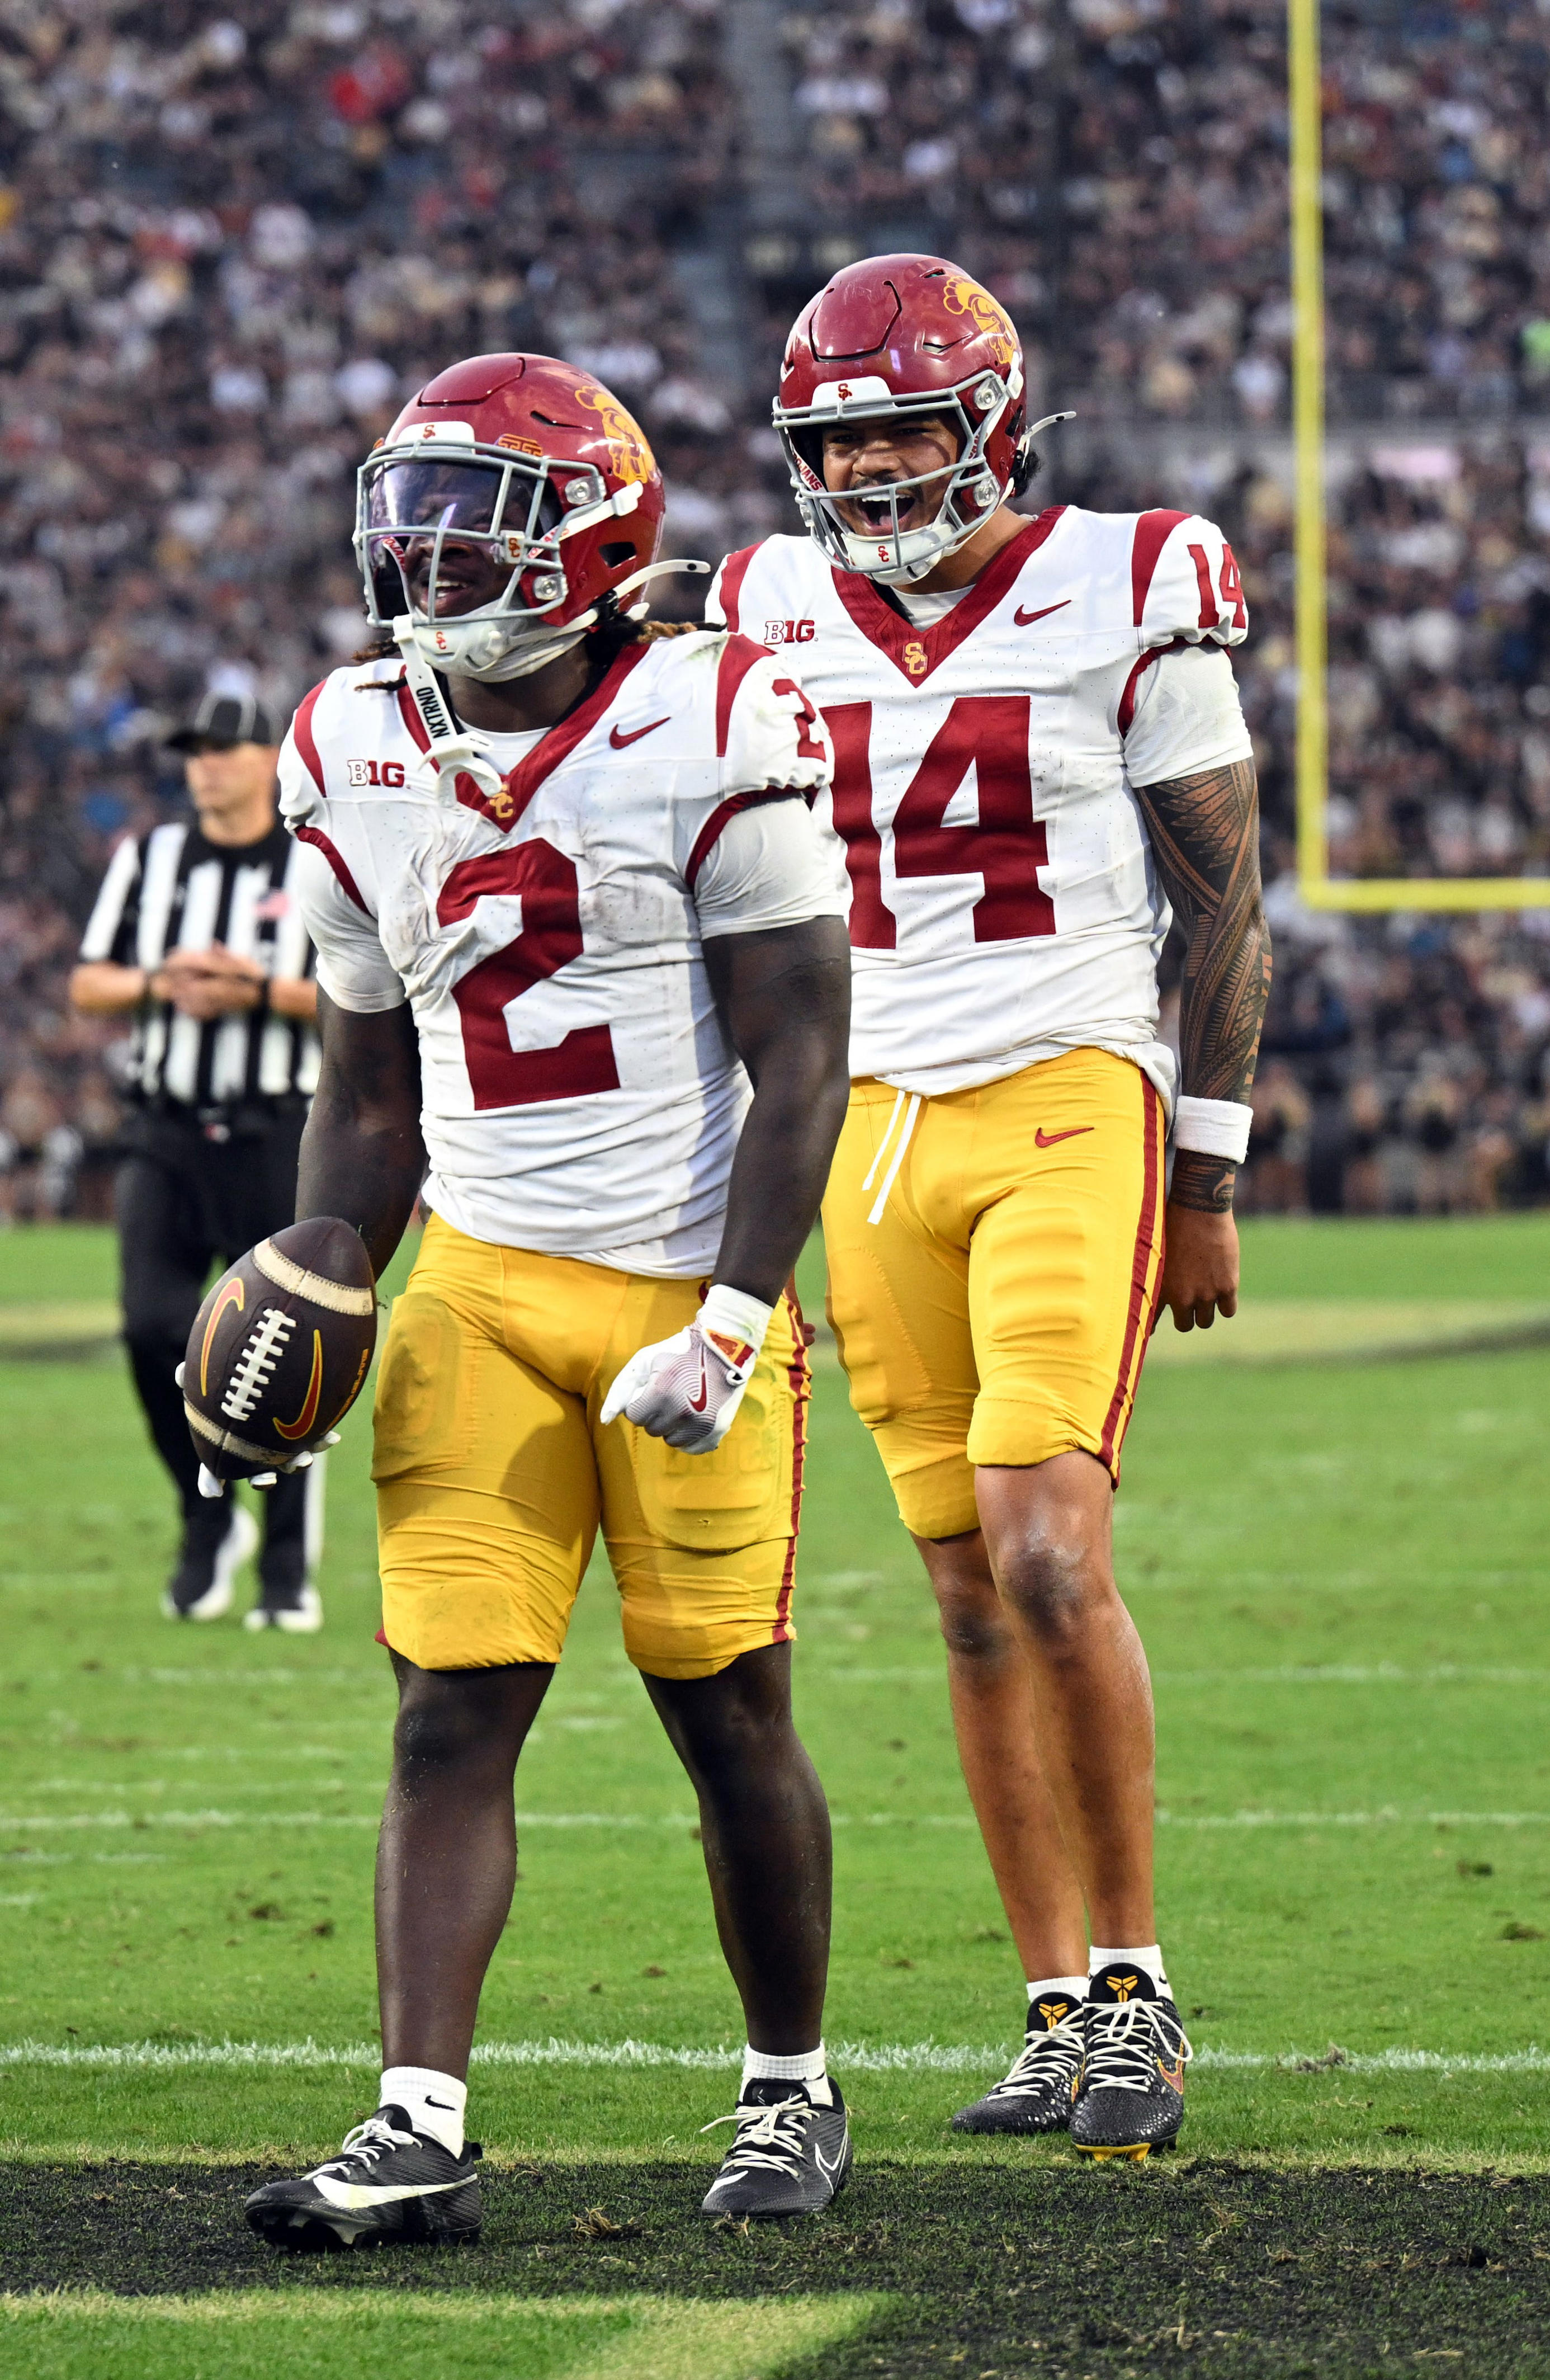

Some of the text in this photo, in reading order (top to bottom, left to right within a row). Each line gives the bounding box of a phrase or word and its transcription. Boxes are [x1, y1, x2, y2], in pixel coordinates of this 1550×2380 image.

[878, 545, 889, 562] SC
[1187, 544, 1244, 629] 14
[436, 631, 446, 649] SC
[904, 642, 927, 675] SC
[416, 686, 450, 738] NXTRND
[819, 695, 1056, 950] 14
[436, 837, 621, 1111] 2
